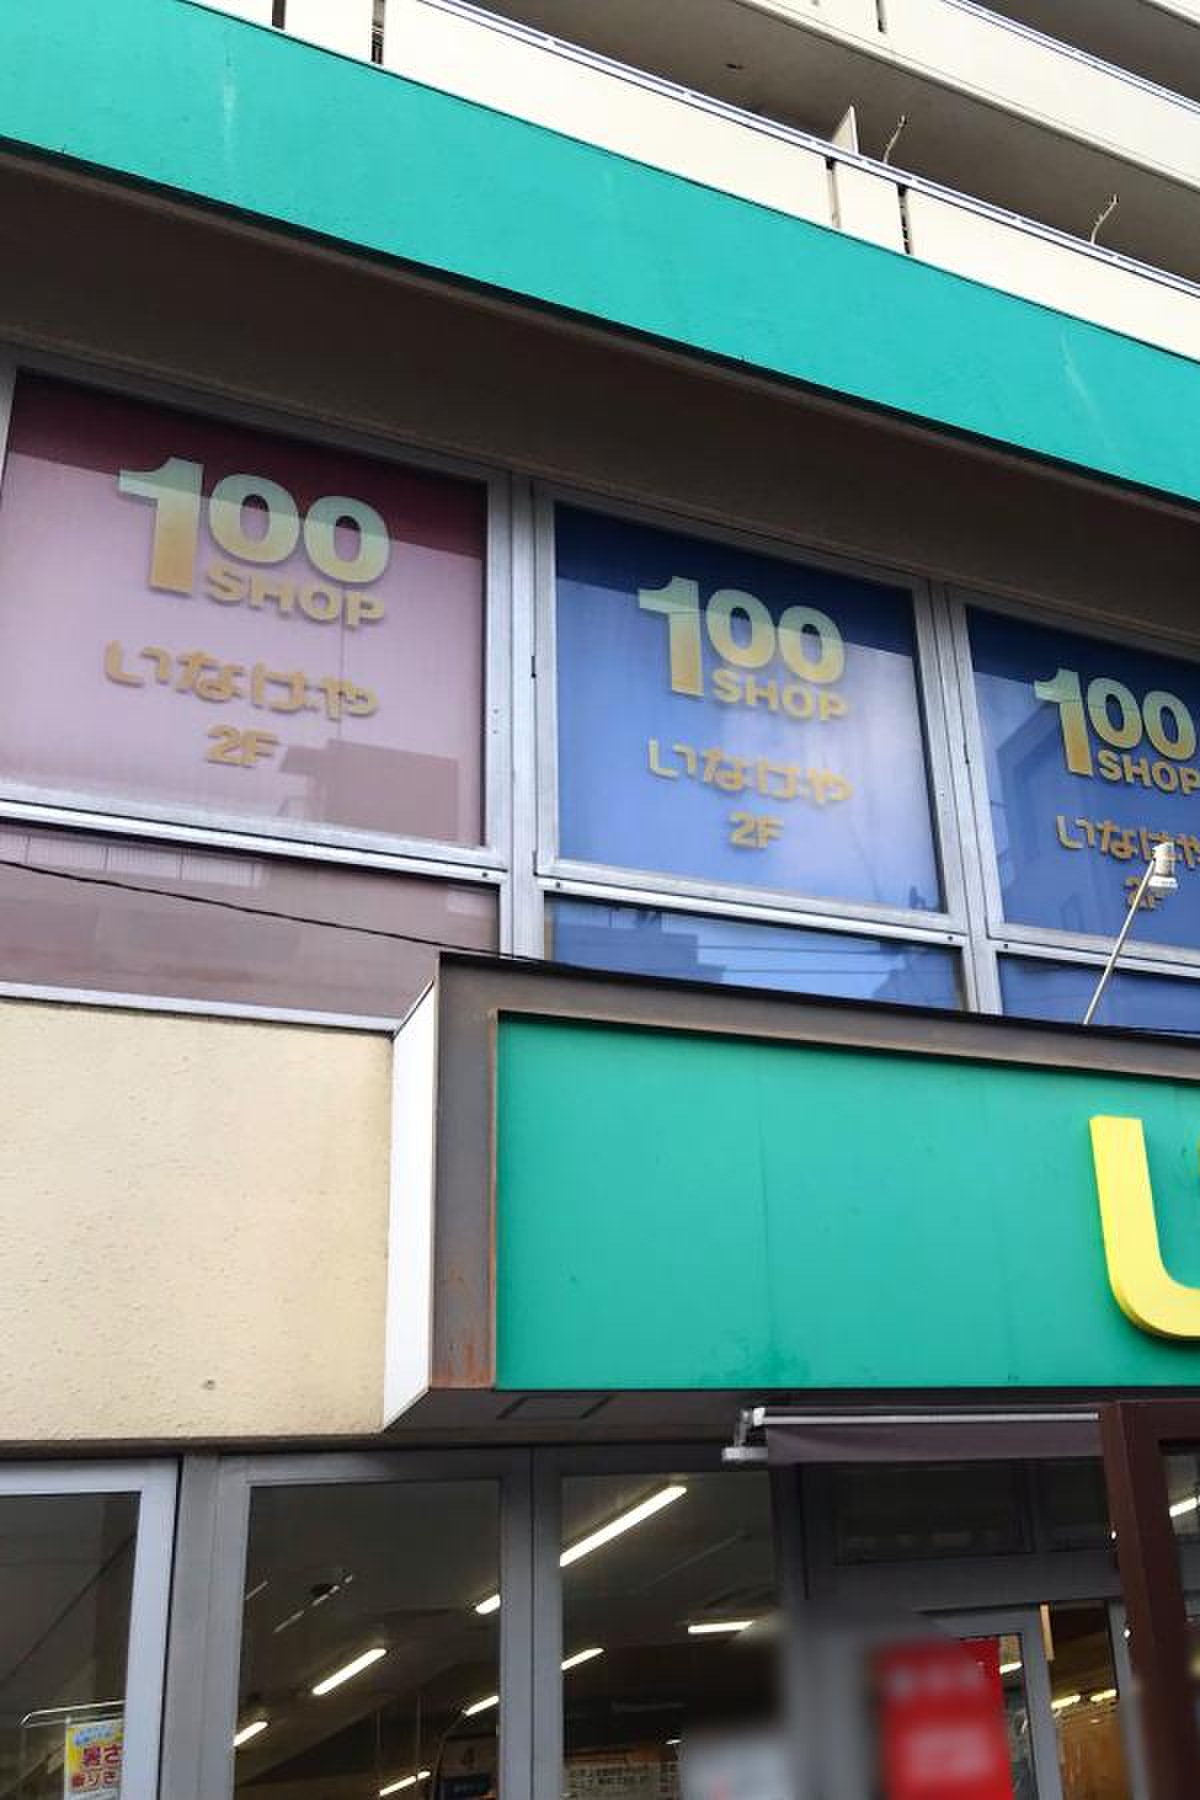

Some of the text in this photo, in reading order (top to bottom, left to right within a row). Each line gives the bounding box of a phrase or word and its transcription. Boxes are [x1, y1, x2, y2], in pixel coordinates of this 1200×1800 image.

[118, 456, 390, 595] 100
[206, 562, 387, 631] SHOP
[637, 576, 845, 698] 100
[712, 668, 850, 724] SHOP
[1034, 668, 1197, 777] 100
[206, 724, 280, 769] 2F
[729, 813, 785, 851] 2F
